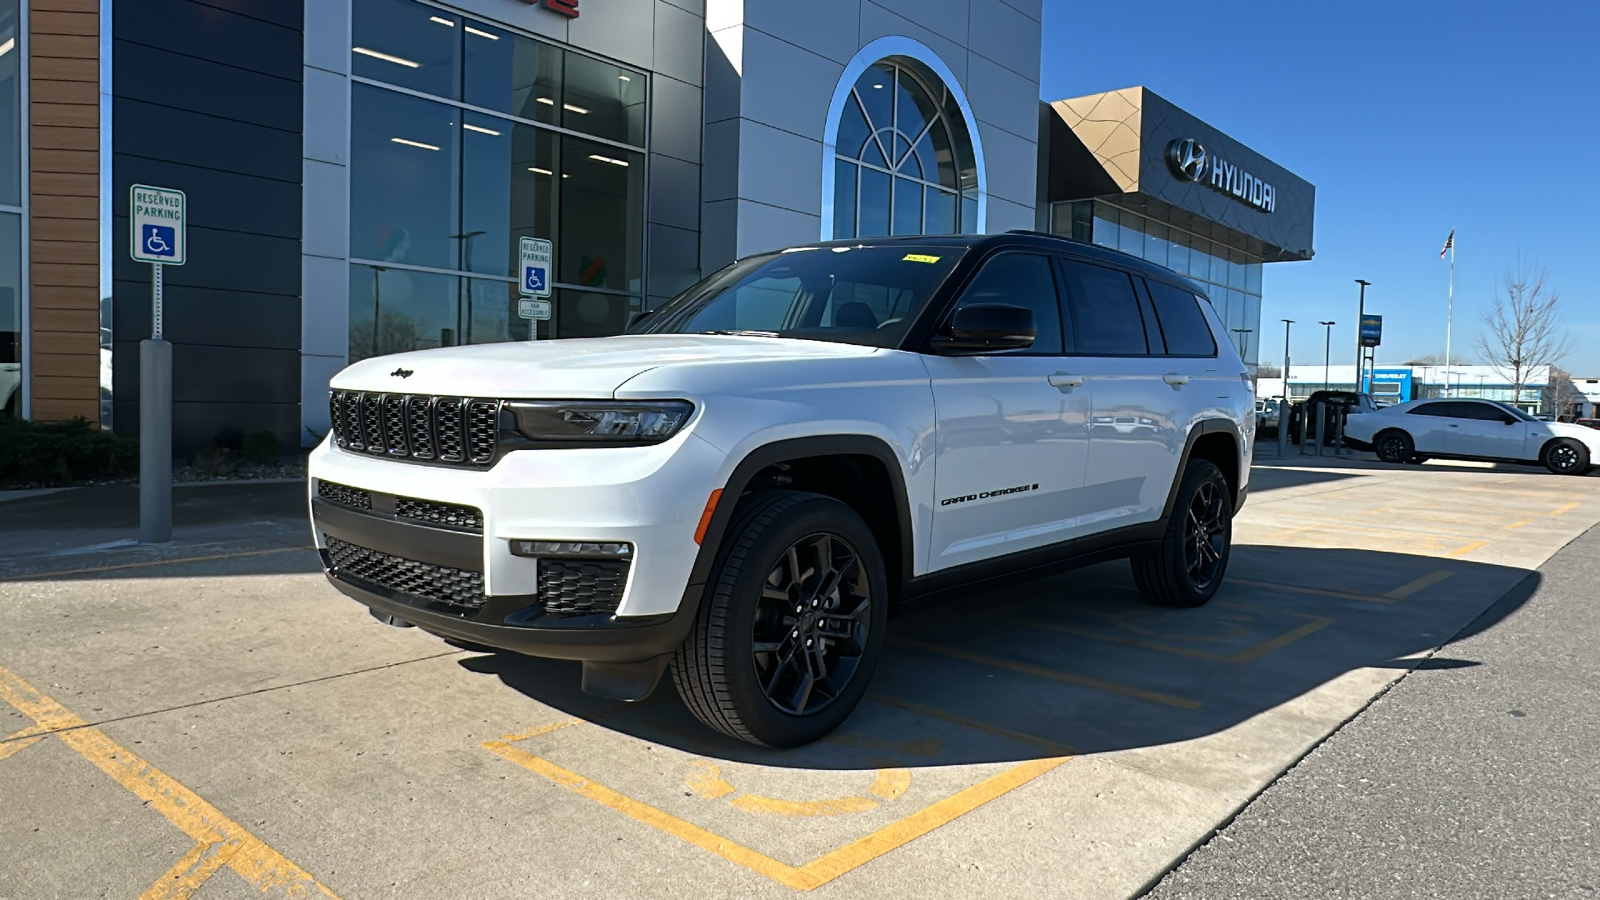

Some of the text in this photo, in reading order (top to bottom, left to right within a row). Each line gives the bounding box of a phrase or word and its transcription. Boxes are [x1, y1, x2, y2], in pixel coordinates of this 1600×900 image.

[1211, 155, 1276, 213] HYUNDAI
[136, 192, 180, 208] RESERVED
[136, 205, 181, 220] PARKING
[523, 242, 549, 254] RESERVED
[523, 252, 549, 263] PARKING
[390, 367, 414, 379] Jeep
[941, 494, 978, 506] GRAND
[979, 484, 1031, 499] CHEROKEE
